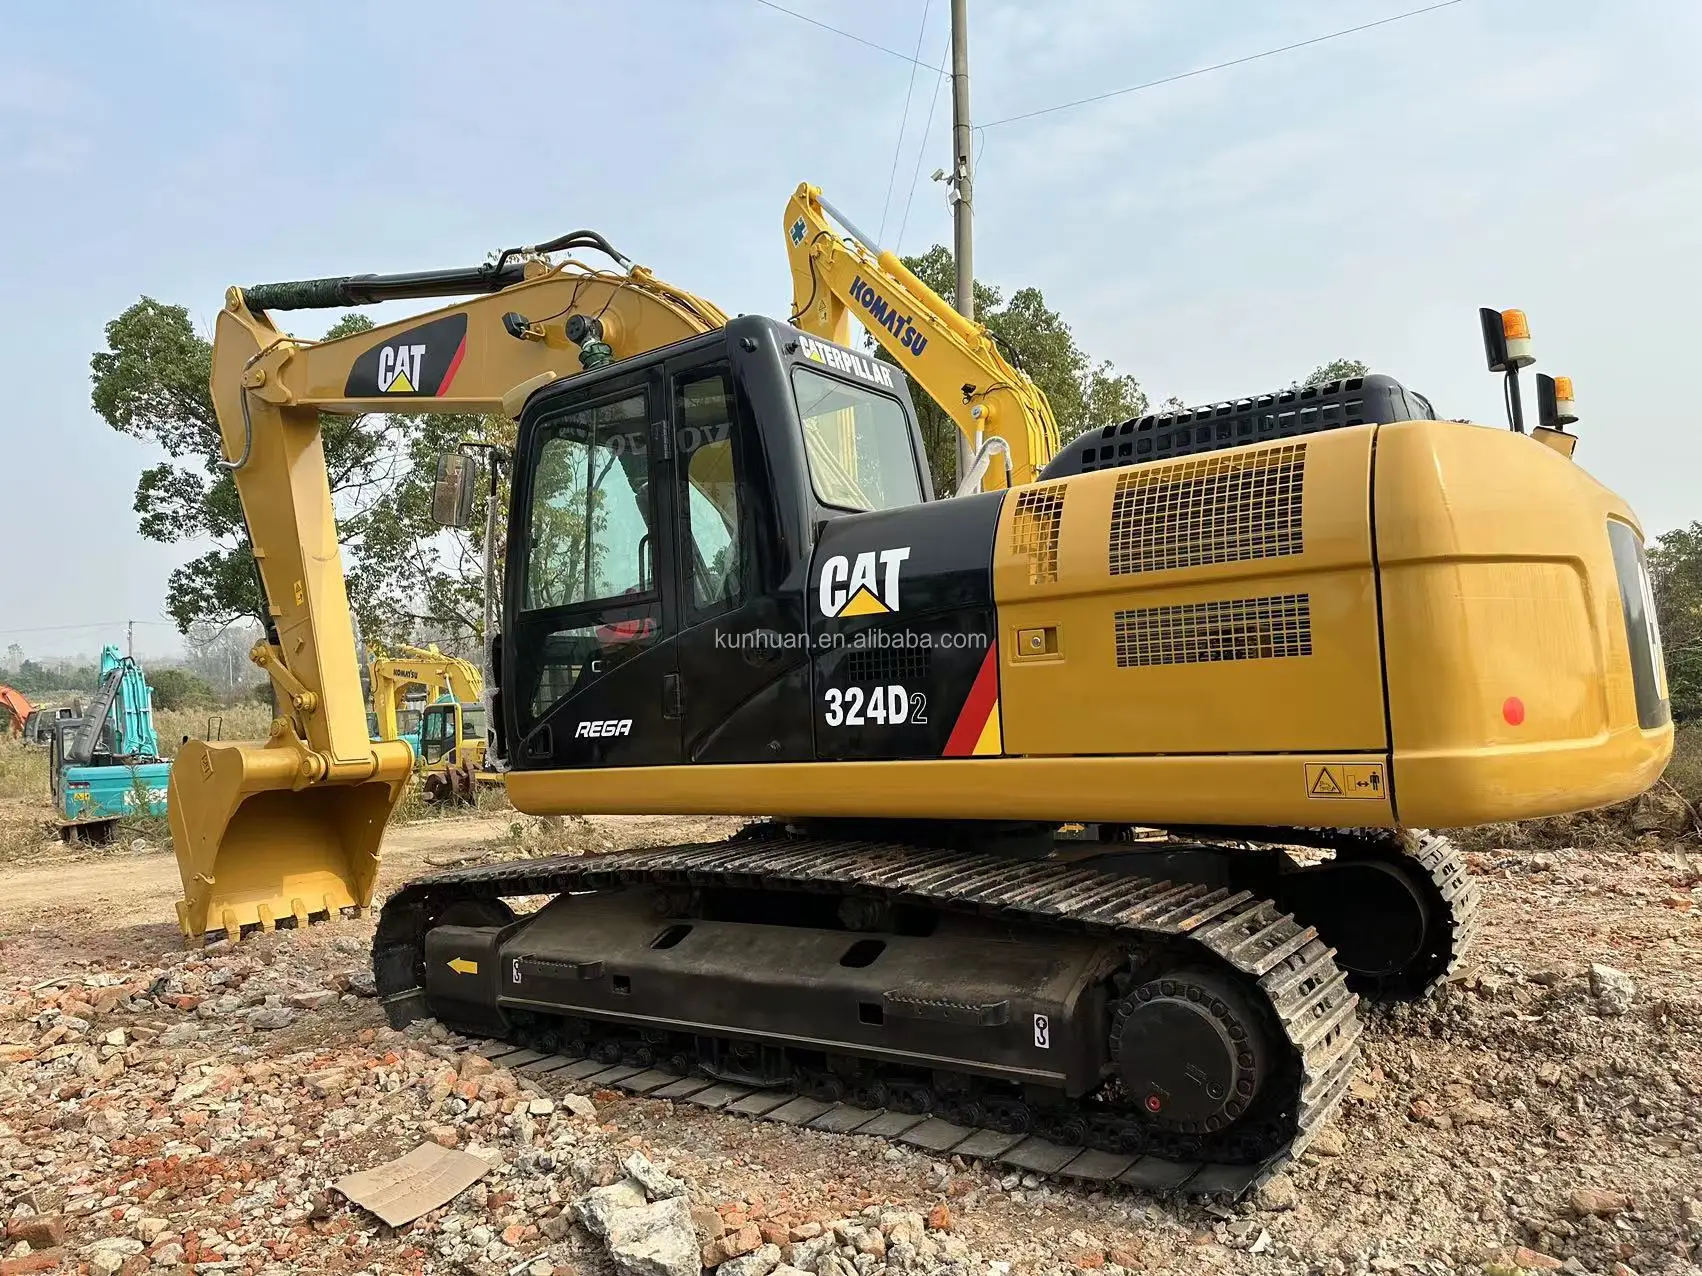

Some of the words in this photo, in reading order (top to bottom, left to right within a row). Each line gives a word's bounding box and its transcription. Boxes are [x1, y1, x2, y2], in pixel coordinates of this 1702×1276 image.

[849, 275, 928, 356] KOMATSU
[378, 344, 426, 392] CAT
[799, 335, 894, 388] CATERPILLAR
[819, 546, 911, 618] CAT
[574, 719, 633, 738] REGA
